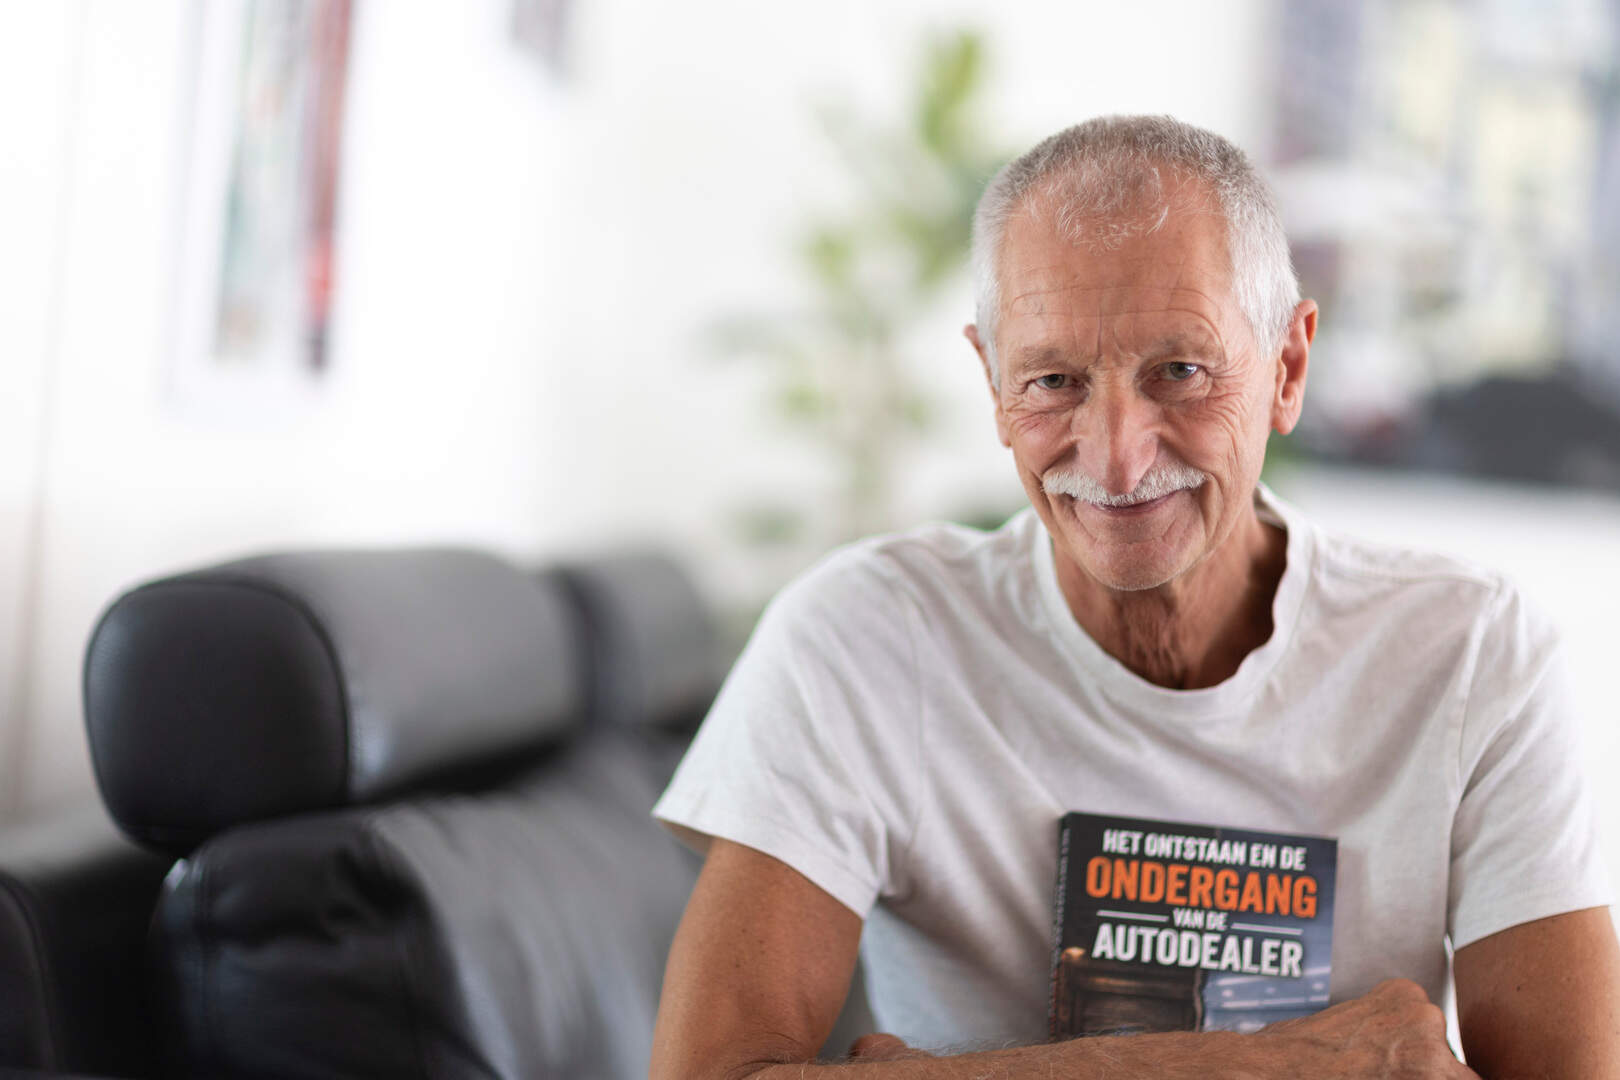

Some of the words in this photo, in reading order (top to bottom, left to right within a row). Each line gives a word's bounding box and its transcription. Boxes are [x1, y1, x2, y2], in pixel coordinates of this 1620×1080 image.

[1102, 829, 1143, 854] HET
[1144, 833, 1246, 865] ONTSTAAN
[1249, 844, 1276, 868] EN
[1280, 847, 1307, 871] DE
[1086, 856, 1317, 918] ONDERGANG
[1173, 908, 1204, 929] VAN
[1206, 912, 1228, 931] DE
[1092, 923, 1303, 977] AUTODEALER
